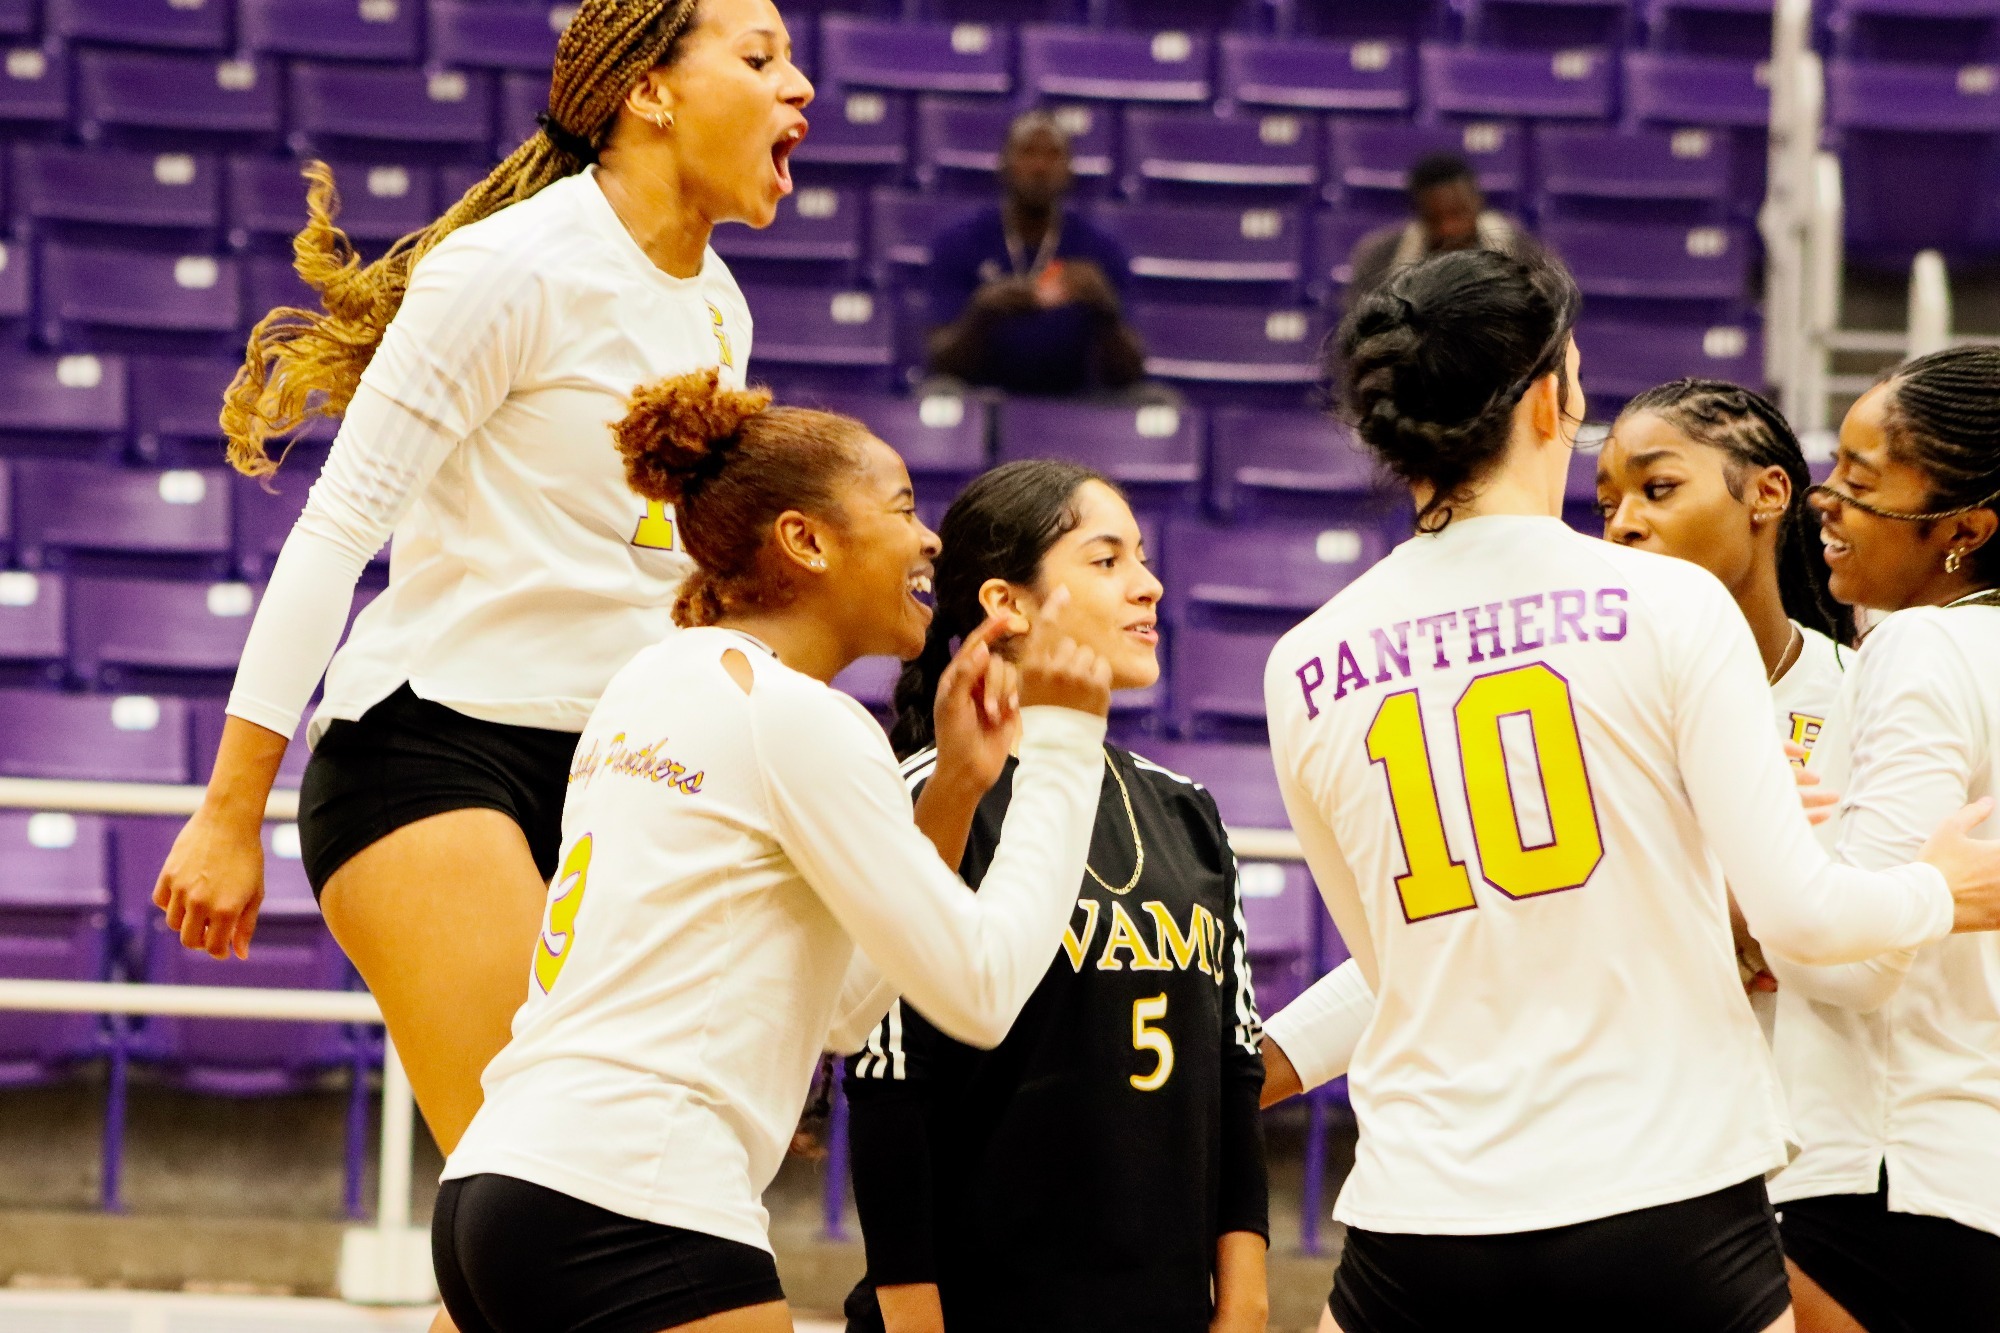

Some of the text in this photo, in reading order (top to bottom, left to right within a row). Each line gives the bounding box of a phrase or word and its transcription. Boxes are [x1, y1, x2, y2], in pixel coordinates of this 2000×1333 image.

[1295, 588, 1628, 721] PANTHERS
[599, 731, 705, 795] Panthers
[1364, 660, 1605, 925] 10
[1129, 991, 1175, 1092] 5
